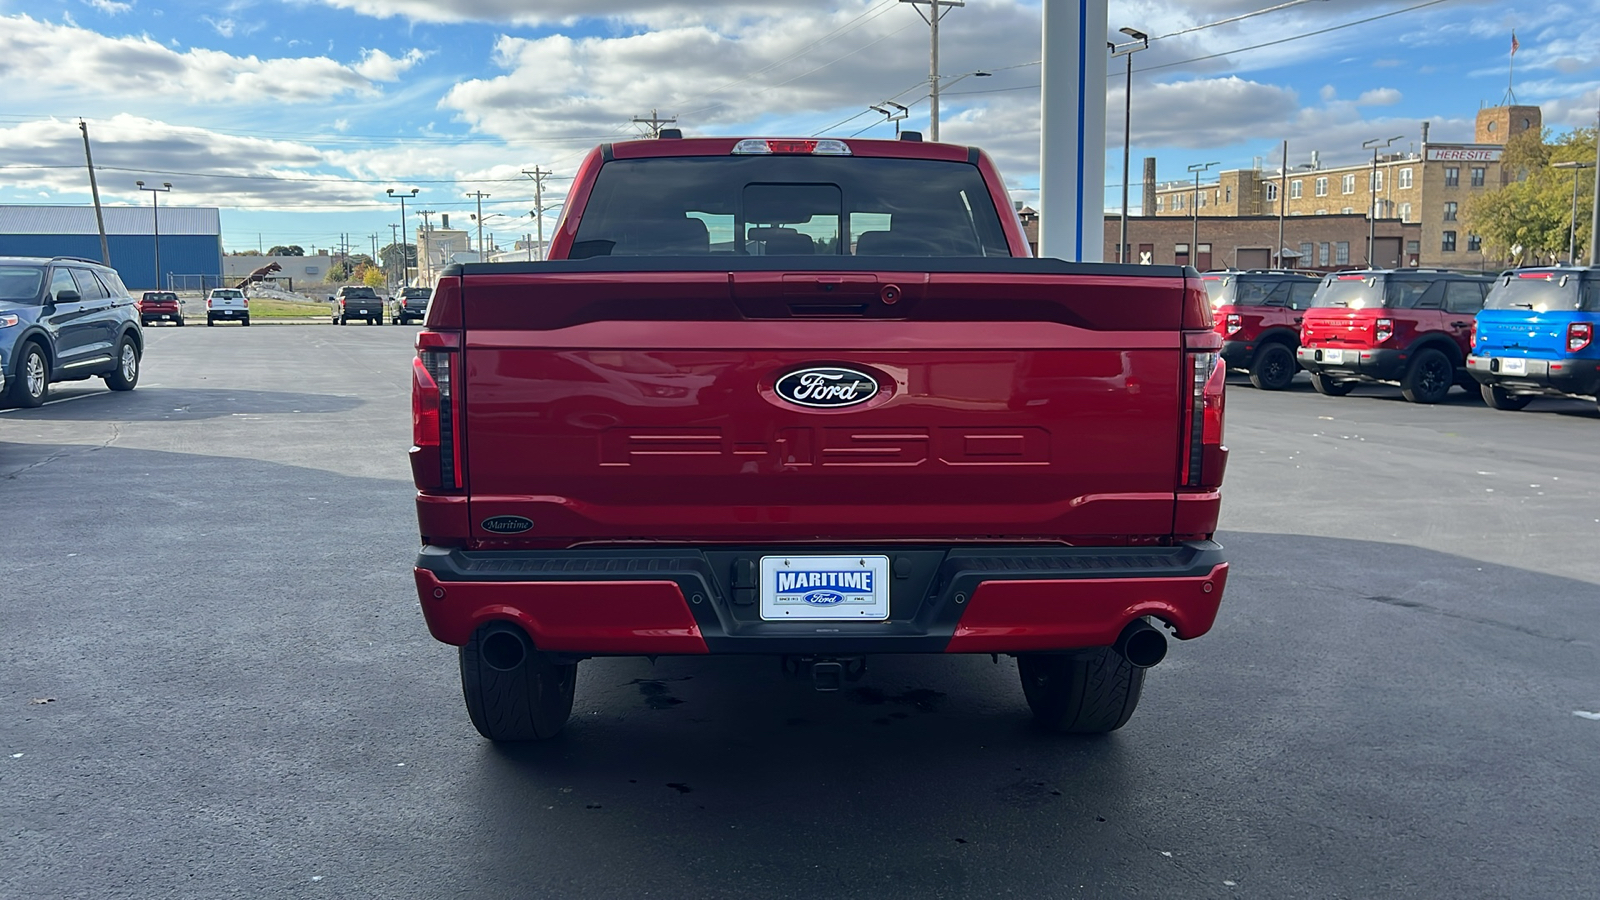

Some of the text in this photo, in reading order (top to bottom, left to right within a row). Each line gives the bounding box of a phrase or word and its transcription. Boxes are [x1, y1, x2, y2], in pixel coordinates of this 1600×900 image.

[1435, 150, 1492, 159] HERESITE
[793, 372, 860, 400] Ford
[599, 426, 1050, 466] F-150
[487, 520, 528, 529] Maritime
[778, 572, 871, 592] MARITIME
[810, 593, 837, 603] Ford
